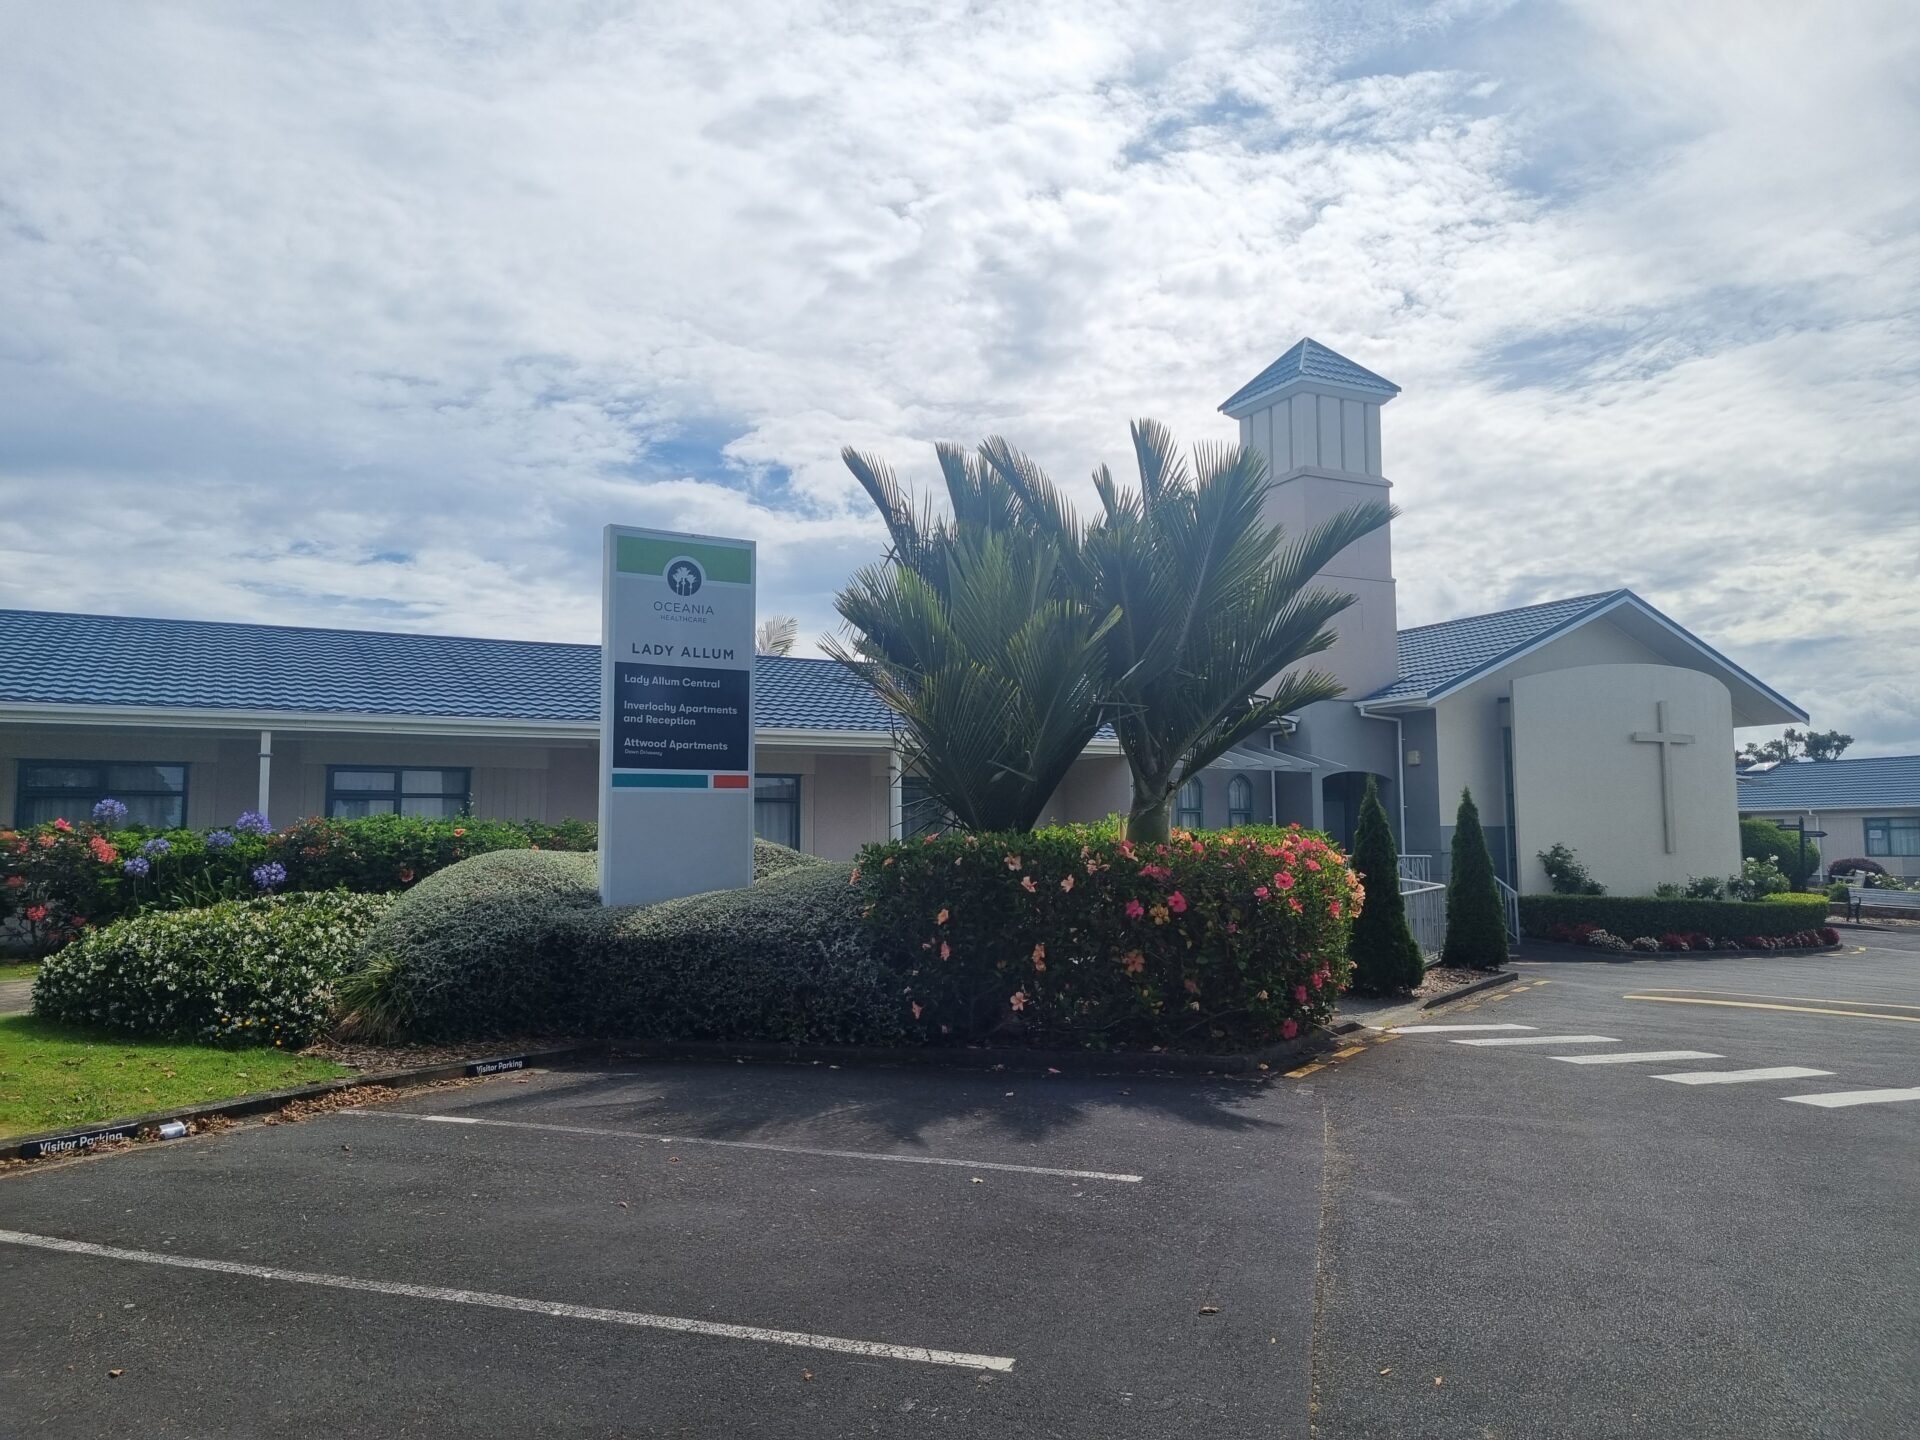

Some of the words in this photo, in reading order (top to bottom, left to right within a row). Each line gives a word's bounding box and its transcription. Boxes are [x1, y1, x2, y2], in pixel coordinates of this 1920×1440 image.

[653, 601, 714, 615] OCEANIA
[660, 615, 707, 623] HEALTHCARE
[632, 642, 674, 656] LADY
[681, 646, 734, 660] ALLUM
[624, 674, 649, 686] Lady
[652, 676, 680, 687] Allum
[682, 678, 720, 688] Central
[624, 701, 677, 714] Inverlochy
[679, 704, 738, 715] Apartments
[623, 715, 643, 723] and
[646, 715, 696, 726] Reception
[624, 738, 667, 748] Attwood
[669, 740, 728, 751] Apartments
[477, 1065, 497, 1073] Visitor
[498, 1060, 522, 1069] Parking
[40, 1140, 77, 1152] Visitor
